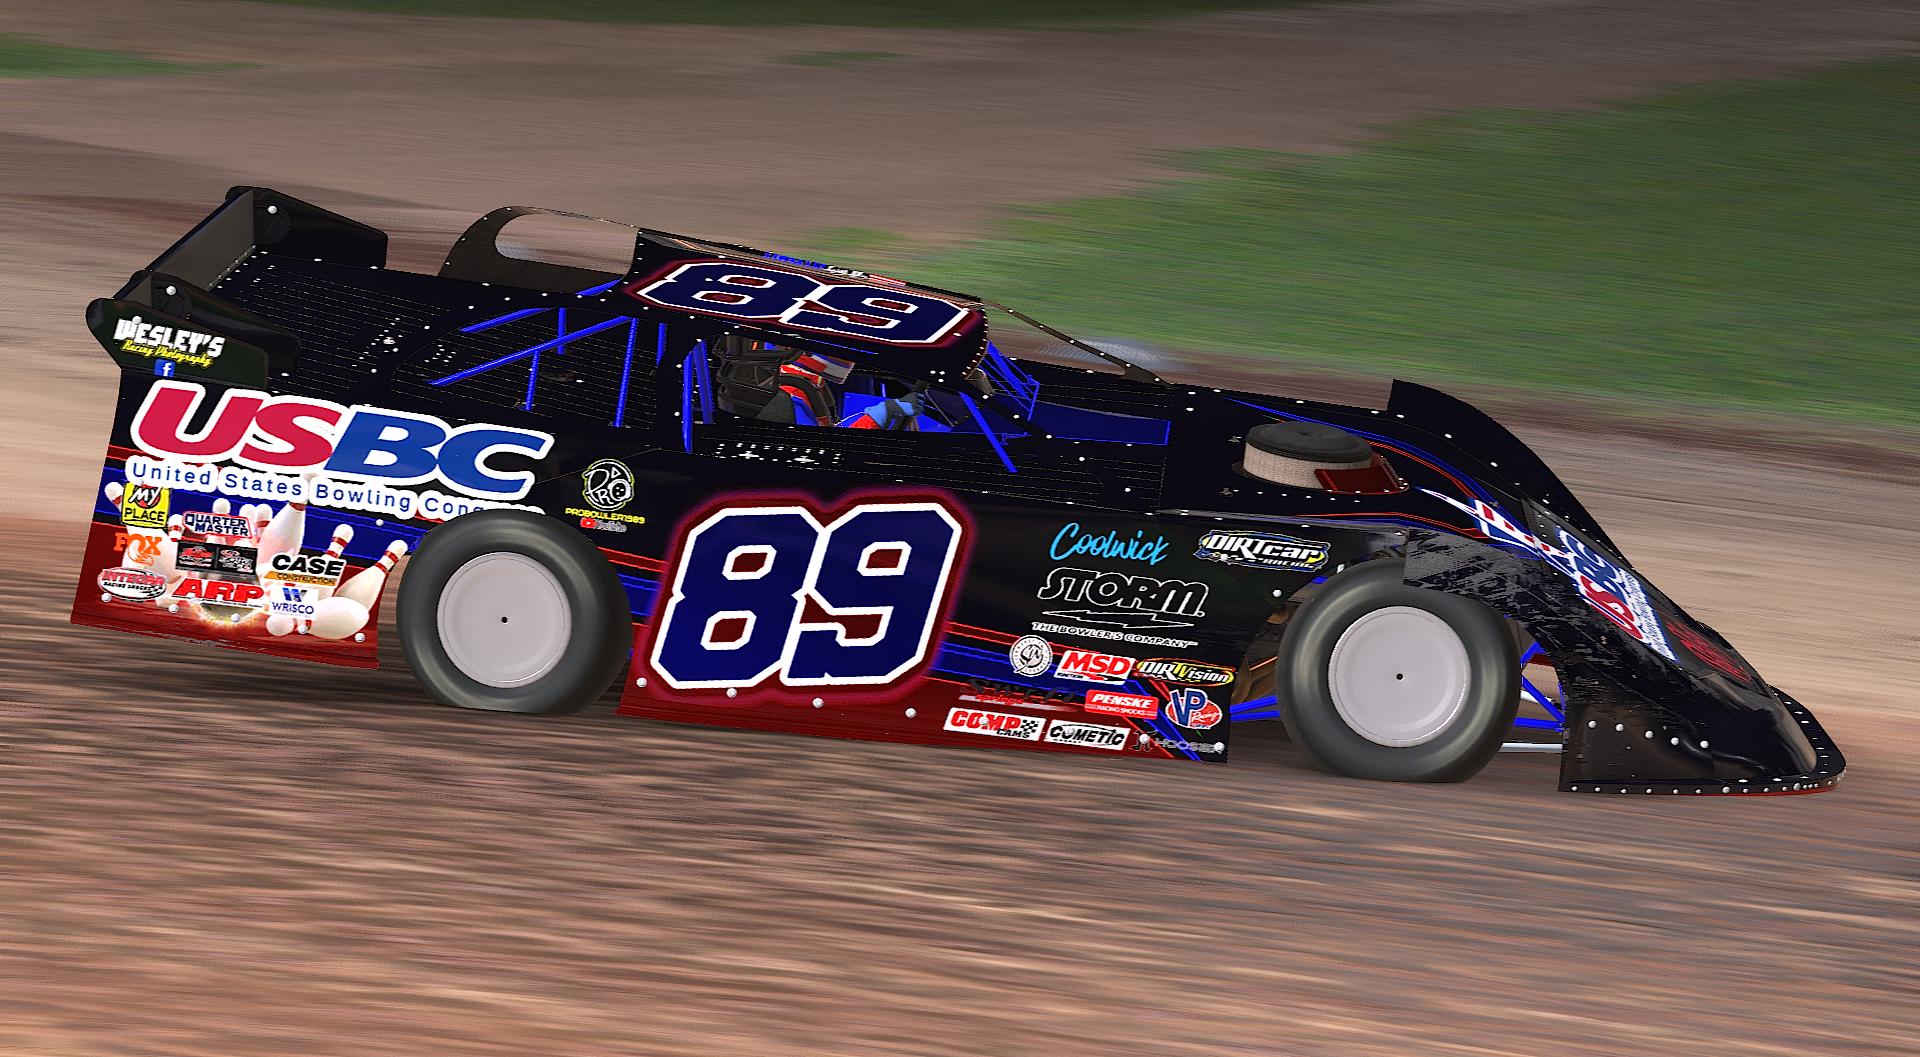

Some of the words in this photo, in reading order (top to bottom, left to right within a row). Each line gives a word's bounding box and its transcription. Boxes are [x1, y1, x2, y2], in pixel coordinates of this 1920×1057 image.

[636, 262, 969, 344] 89
[113, 318, 225, 357] WESLEY'S
[122, 339, 153, 358] Racing
[154, 345, 214, 369] Photography
[136, 386, 548, 494] USBC
[132, 462, 211, 485] United
[225, 473, 302, 496] States
[315, 483, 411, 512] Bowling
[125, 508, 165, 521] PLACE
[184, 513, 247, 528] QUARTER
[194, 523, 249, 536] MASTER
[113, 531, 162, 557] FOX
[1050, 522, 1170, 565] Coolwick
[1205, 534, 1323, 560] DIRTcar
[272, 554, 345, 576] CASE
[172, 578, 264, 603] ARP
[276, 573, 336, 586] CONSTRUCTION
[272, 602, 315, 615] WRISCO
[650, 502, 962, 690] 89
[1032, 621, 1058, 632] THE
[1124, 633, 1189, 648] COMPANY
[1061, 651, 1131, 676] MSD
[1091, 693, 1154, 709] PENSKE
[1169, 688, 1208, 727] VP
[950, 710, 1022, 732] COMP
[996, 728, 1031, 739] CAMS
